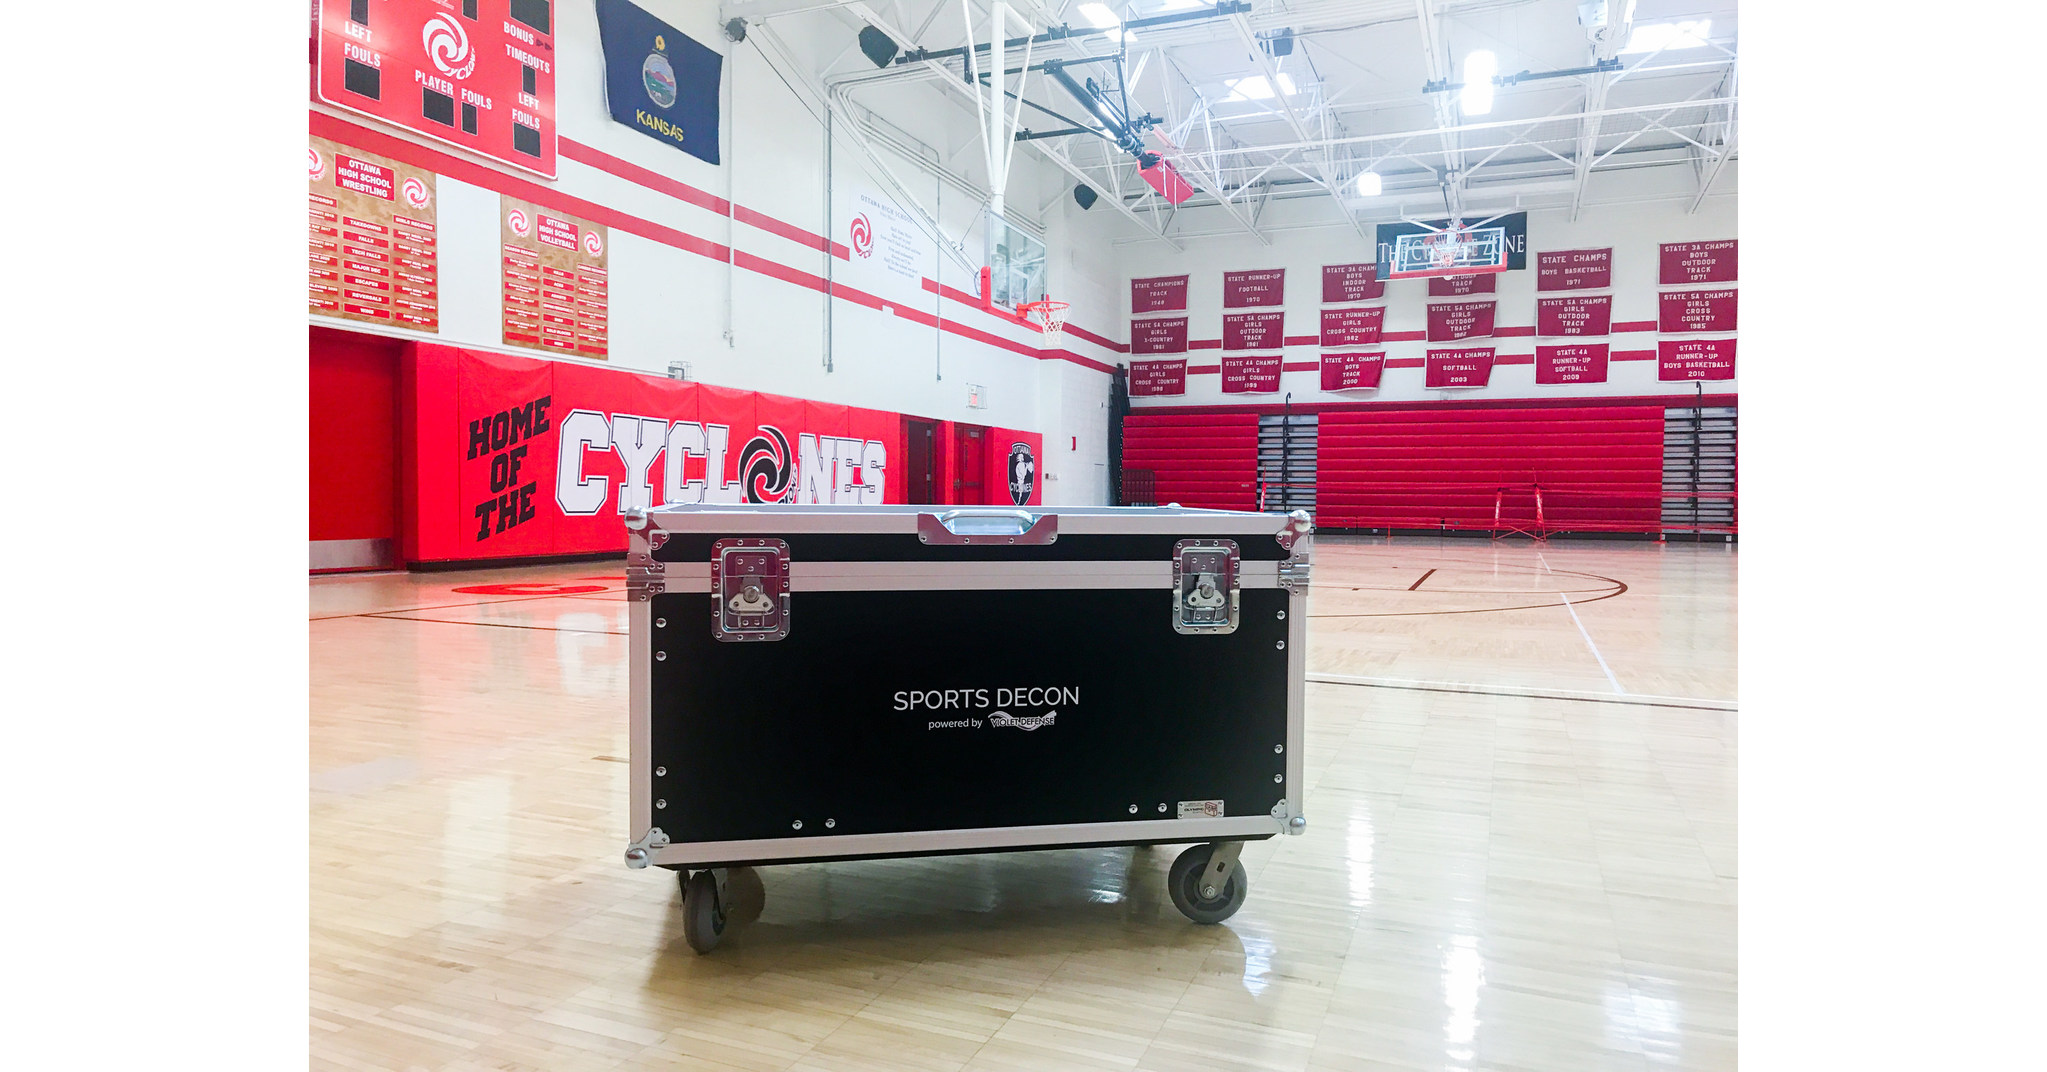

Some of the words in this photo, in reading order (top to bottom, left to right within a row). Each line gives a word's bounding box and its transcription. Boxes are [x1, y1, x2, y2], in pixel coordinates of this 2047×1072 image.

[345, 20, 373, 43] LEFT
[503, 21, 534, 45] BONUS
[344, 42, 381, 67] FOULS
[505, 44, 550, 74] TIMEOUTS
[415, 70, 454, 96] PLAYER
[461, 88, 492, 110] FOULS
[518, 92, 540, 110] LEFT
[512, 109, 540, 129] FOULS
[636, 109, 684, 142] KANSAS
[338, 167, 358, 179] HIGH
[360, 172, 392, 189] SCHOOL
[348, 160, 381, 176] OTTAWA
[342, 178, 388, 198] WRESTLING
[539, 225, 553, 234] HIGH
[554, 229, 576, 241] SCHOOL
[546, 218, 569, 231] OTTAWA
[540, 234, 575, 249] VOLLEYBALL
[1483, 234, 1524, 256] ZONE
[1705, 242, 1734, 250] CHAMPS
[1574, 253, 1607, 262] CHAMPS
[1565, 266, 1607, 274] BASKETBALL
[467, 395, 551, 460] HOME
[490, 448, 522, 493] OF
[475, 482, 536, 542] THE
[893, 689, 990, 711] SPORTS
[997, 686, 1079, 708] DECON
[929, 718, 969, 730] powered
[972, 718, 983, 729] by
[990, 717, 1019, 728] VIOLET
[1020, 716, 1055, 726] DEFENSE
